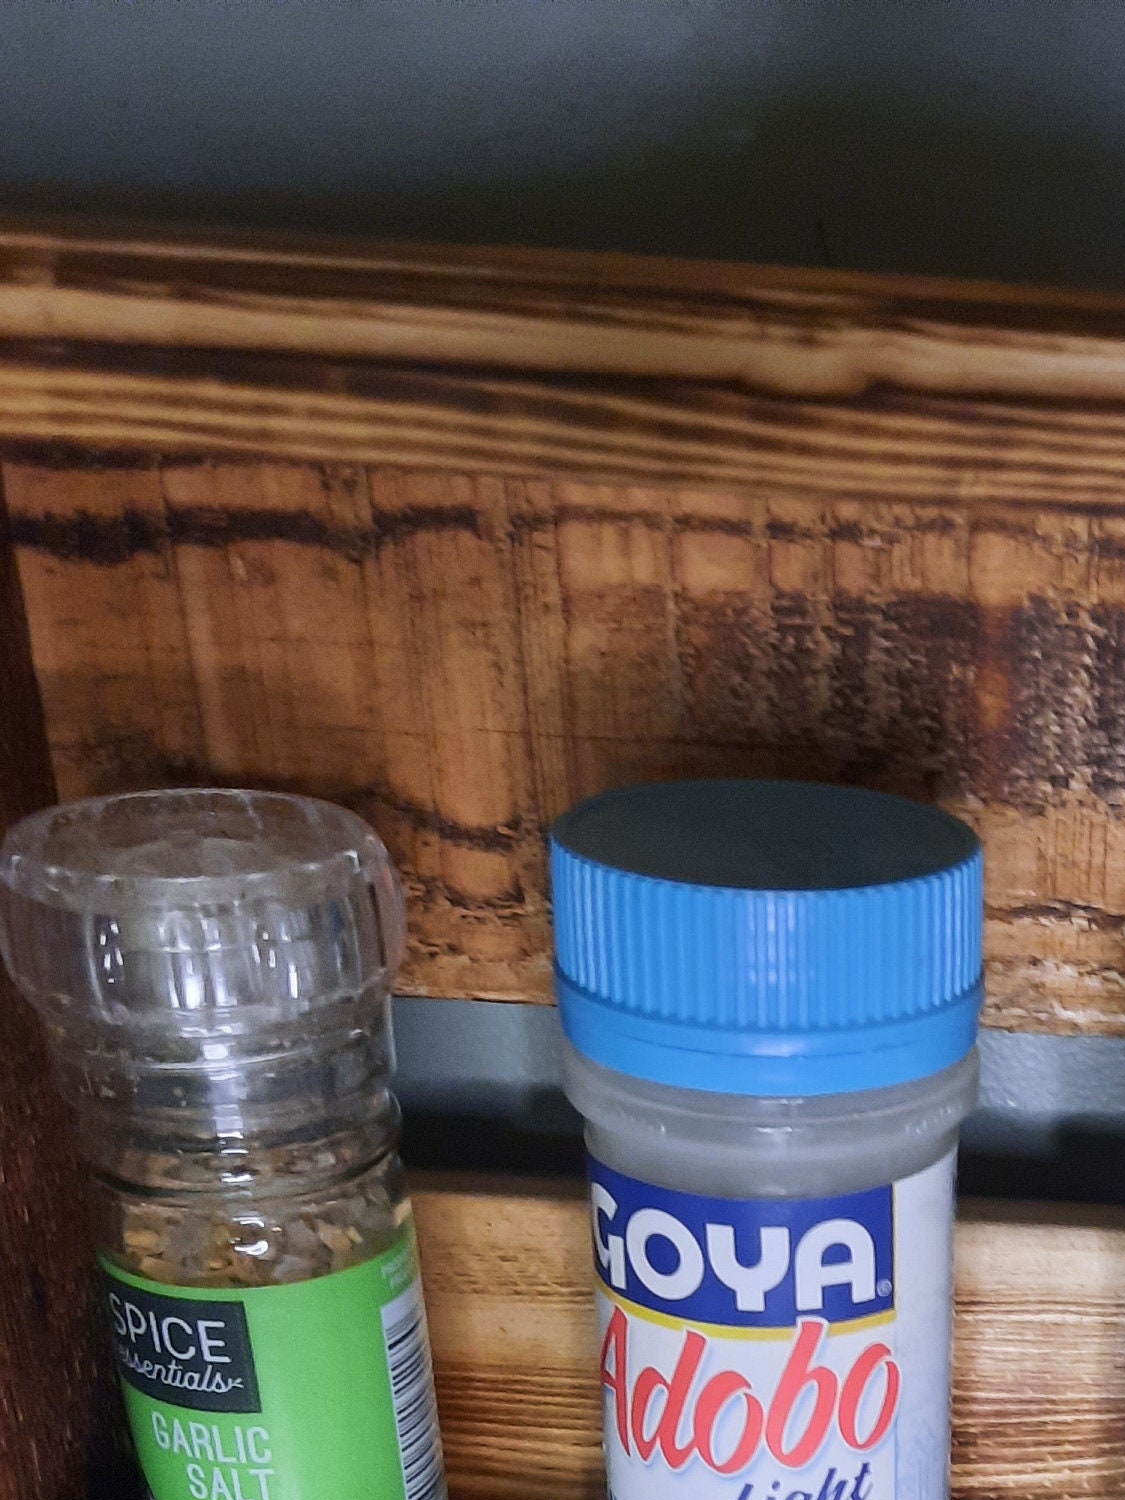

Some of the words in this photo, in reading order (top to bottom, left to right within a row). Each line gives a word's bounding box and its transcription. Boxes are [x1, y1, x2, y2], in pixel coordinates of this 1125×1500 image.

[590, 1184, 878, 1312] GOYA
[108, 1292, 232, 1363] SPICE
[151, 1411, 272, 1464] GARLIC
[602, 1306, 900, 1475] Adobo
